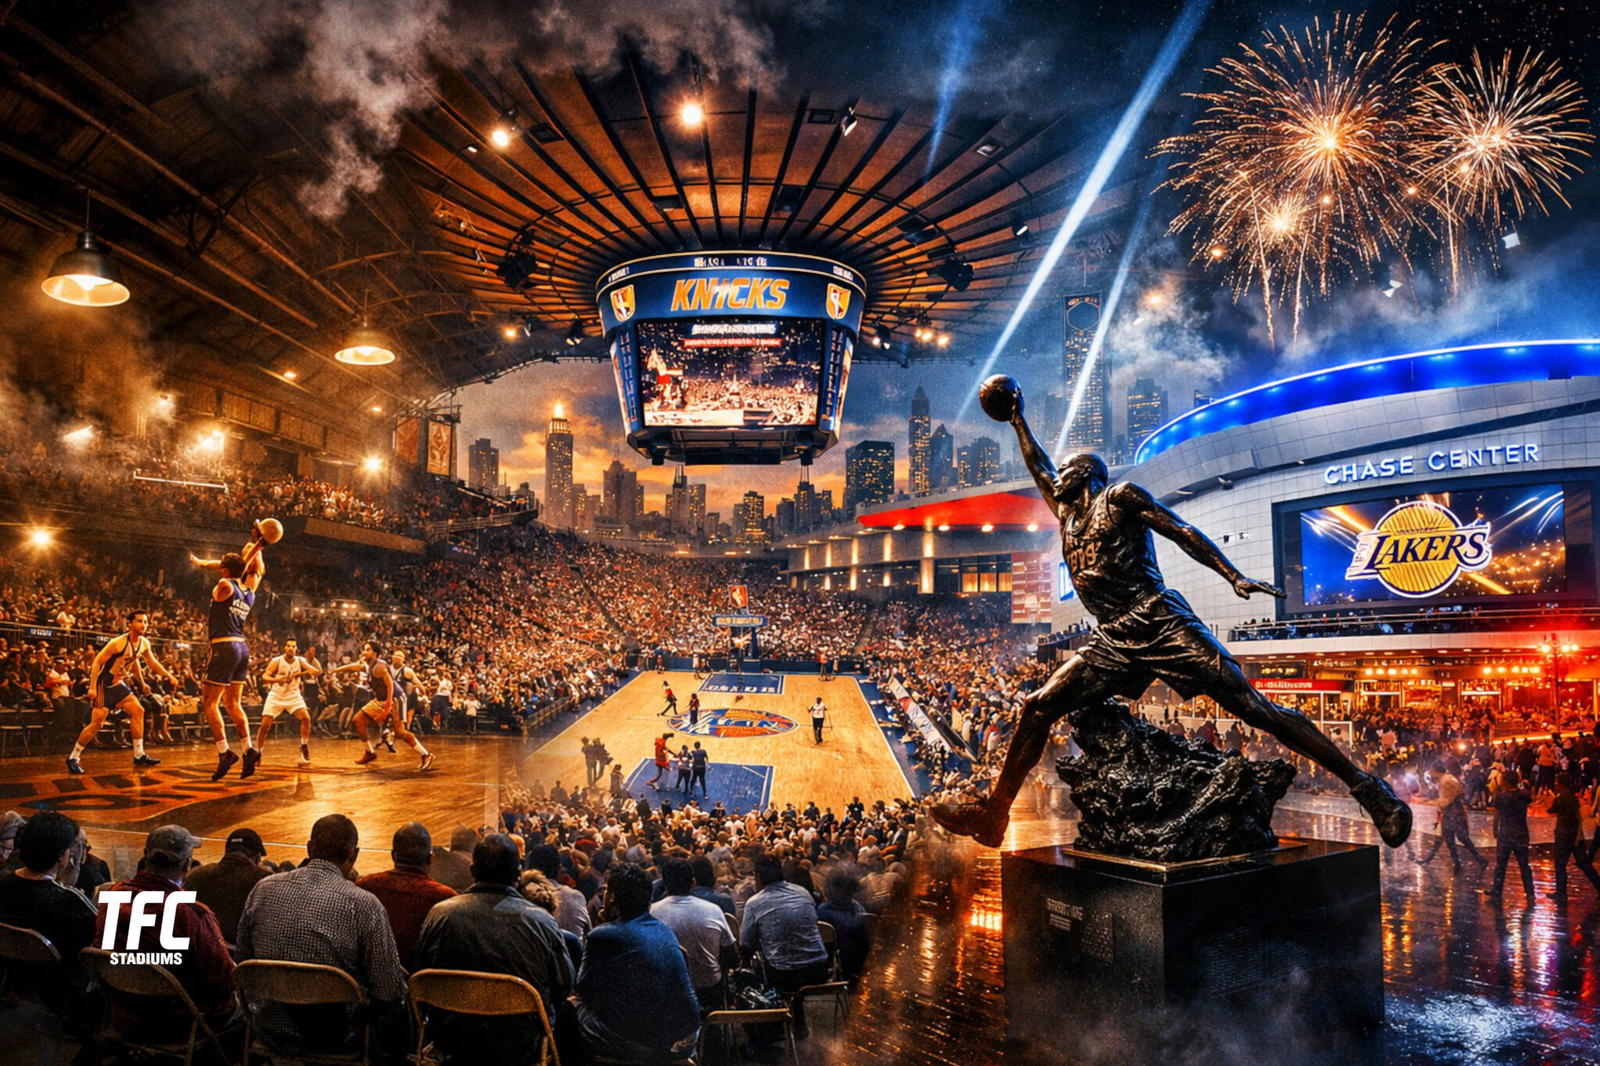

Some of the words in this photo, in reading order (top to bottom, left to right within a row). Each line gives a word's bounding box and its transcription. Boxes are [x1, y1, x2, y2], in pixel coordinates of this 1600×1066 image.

[671, 277, 790, 311] KNICKS
[1324, 455, 1414, 485] CHASE
[1428, 443, 1539, 471] CENTER
[1363, 531, 1487, 571] LAKERS
